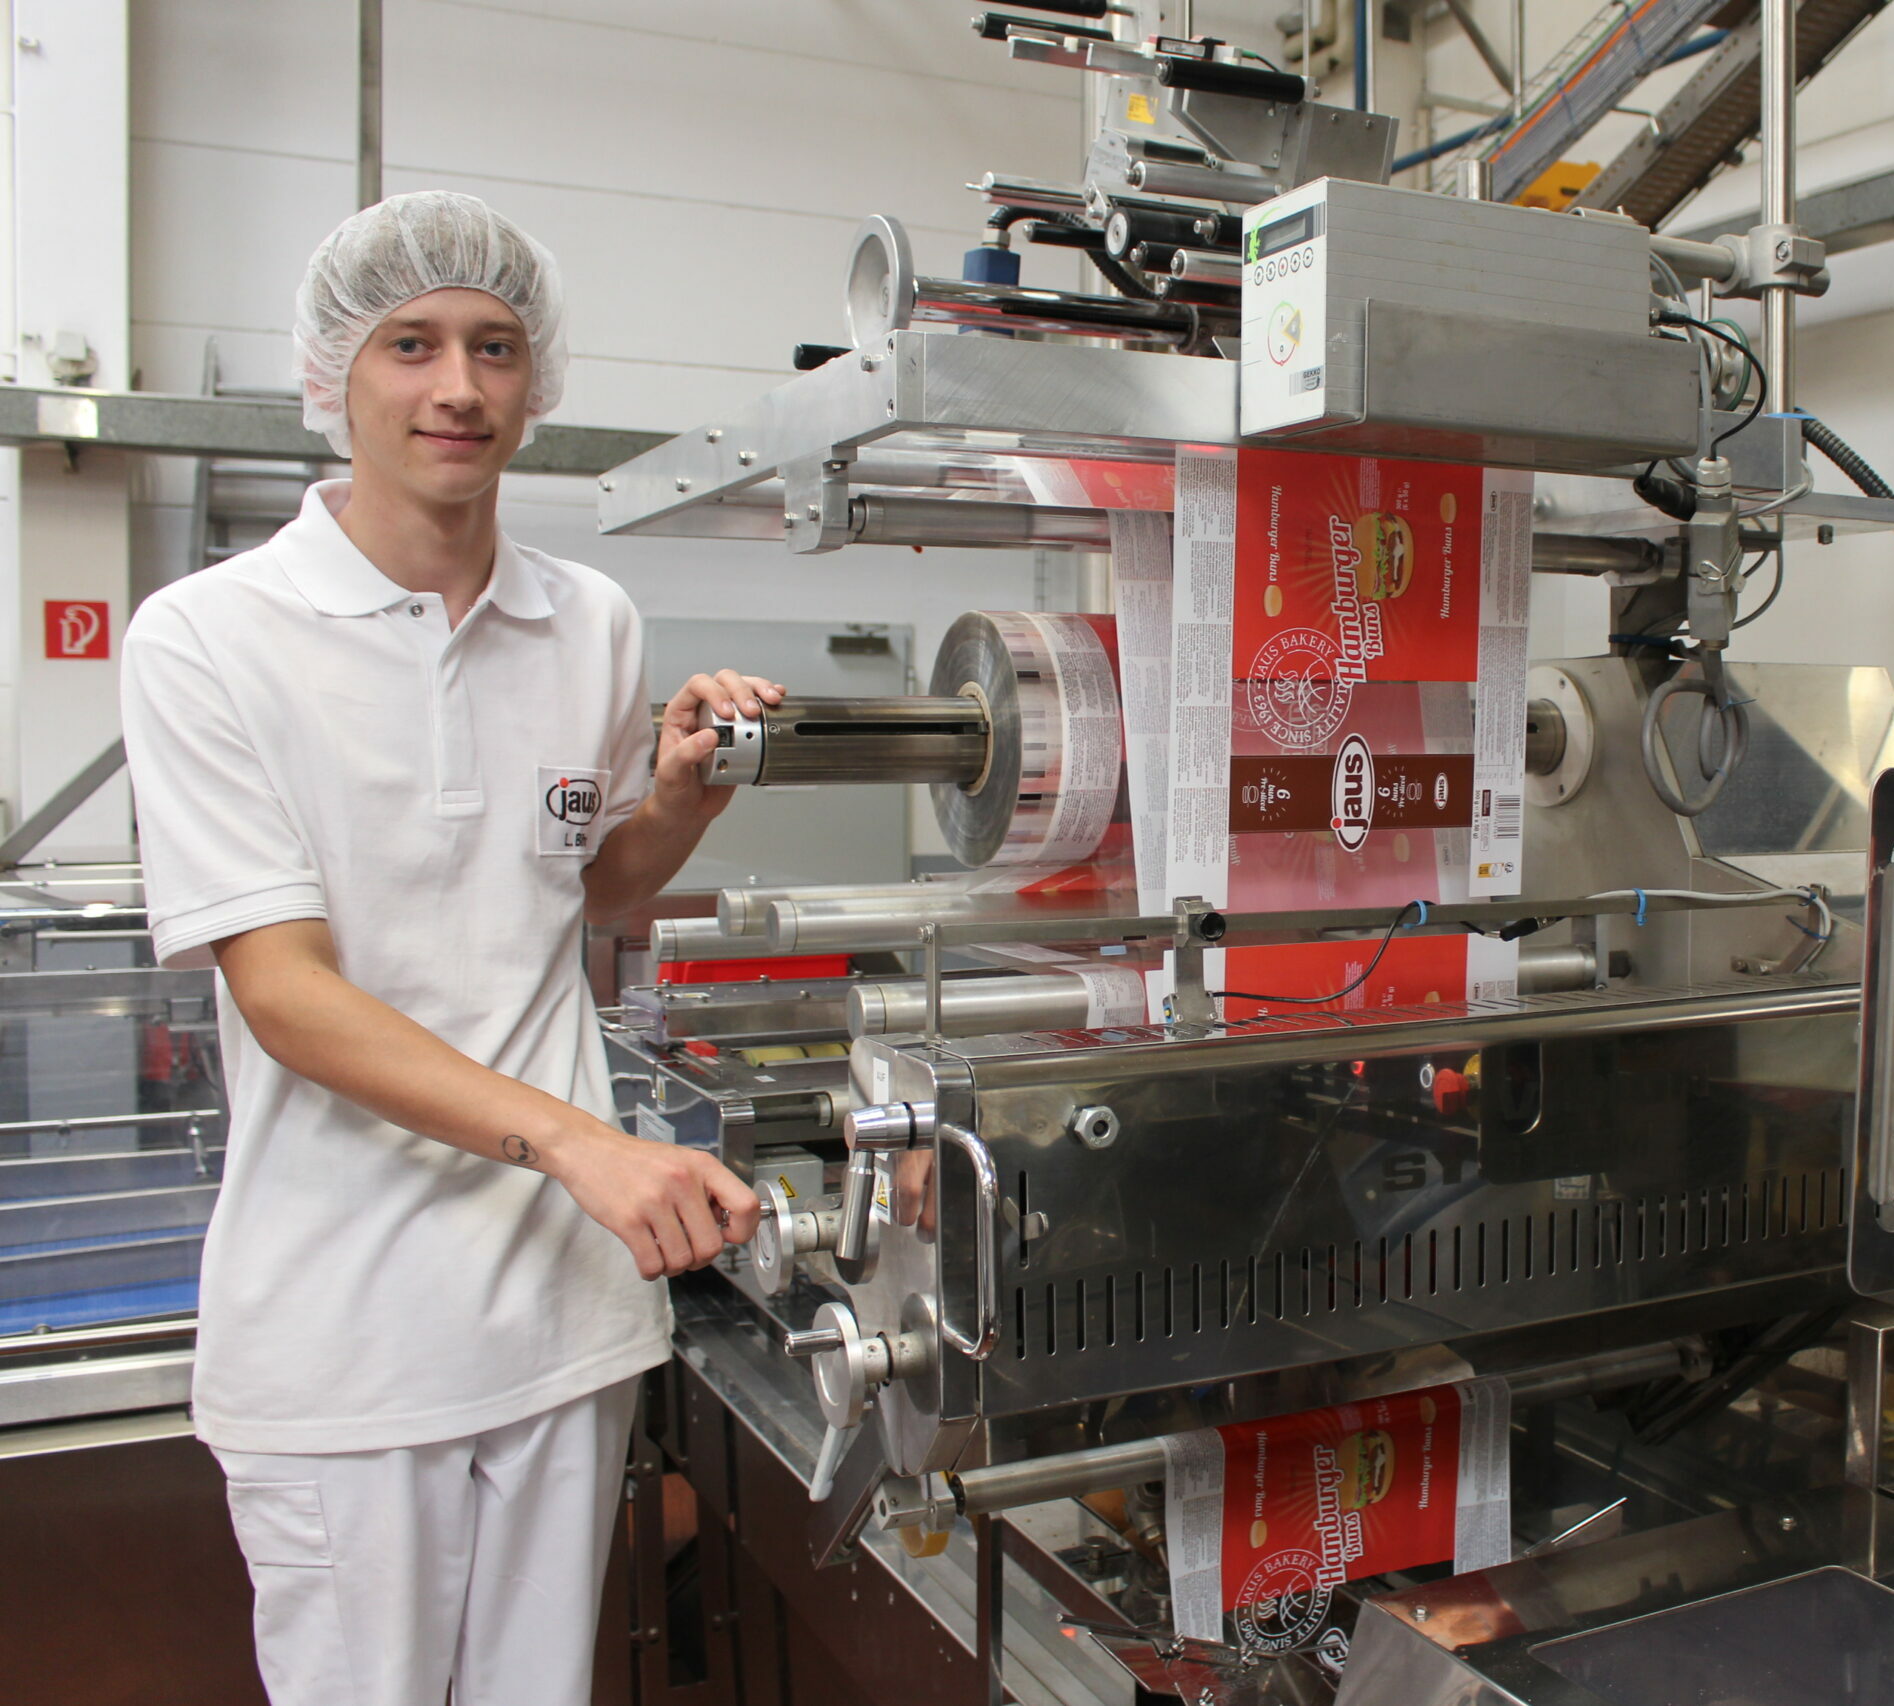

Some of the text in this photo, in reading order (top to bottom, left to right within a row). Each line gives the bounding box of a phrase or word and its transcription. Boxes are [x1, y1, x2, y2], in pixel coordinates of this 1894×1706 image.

[1267, 485, 1282, 582] Hamburger Buns
[1440, 527, 1453, 619] Hamburger Buns
[1328, 515, 1367, 687] Hamburger
[1257, 631, 1335, 679] JAUS BAKERY
[1363, 602, 1384, 661] Buns
[1253, 675, 1348, 743] UALITY SINCE 1963
[559, 777, 596, 821] jaus
[1268, 784, 1276, 803] buns
[1277, 789, 1290, 799] 6
[1330, 753, 1370, 833] jaus
[1377, 787, 1391, 797] 6
[1390, 782, 1399, 802] buns
[1433, 779, 1446, 803] jaus
[1254, 1430, 1268, 1518] Hamburger Buns
[1419, 1427, 1433, 1510] Hamburger Buns
[1313, 1444, 1347, 1589] Hamburger
[1344, 1512, 1364, 1562] Buns
[1241, 1554, 1316, 1606] JAUS BAKERY
[1296, 1585, 1328, 1640] UALITY
[1254, 1636, 1293, 1653] SINCE
